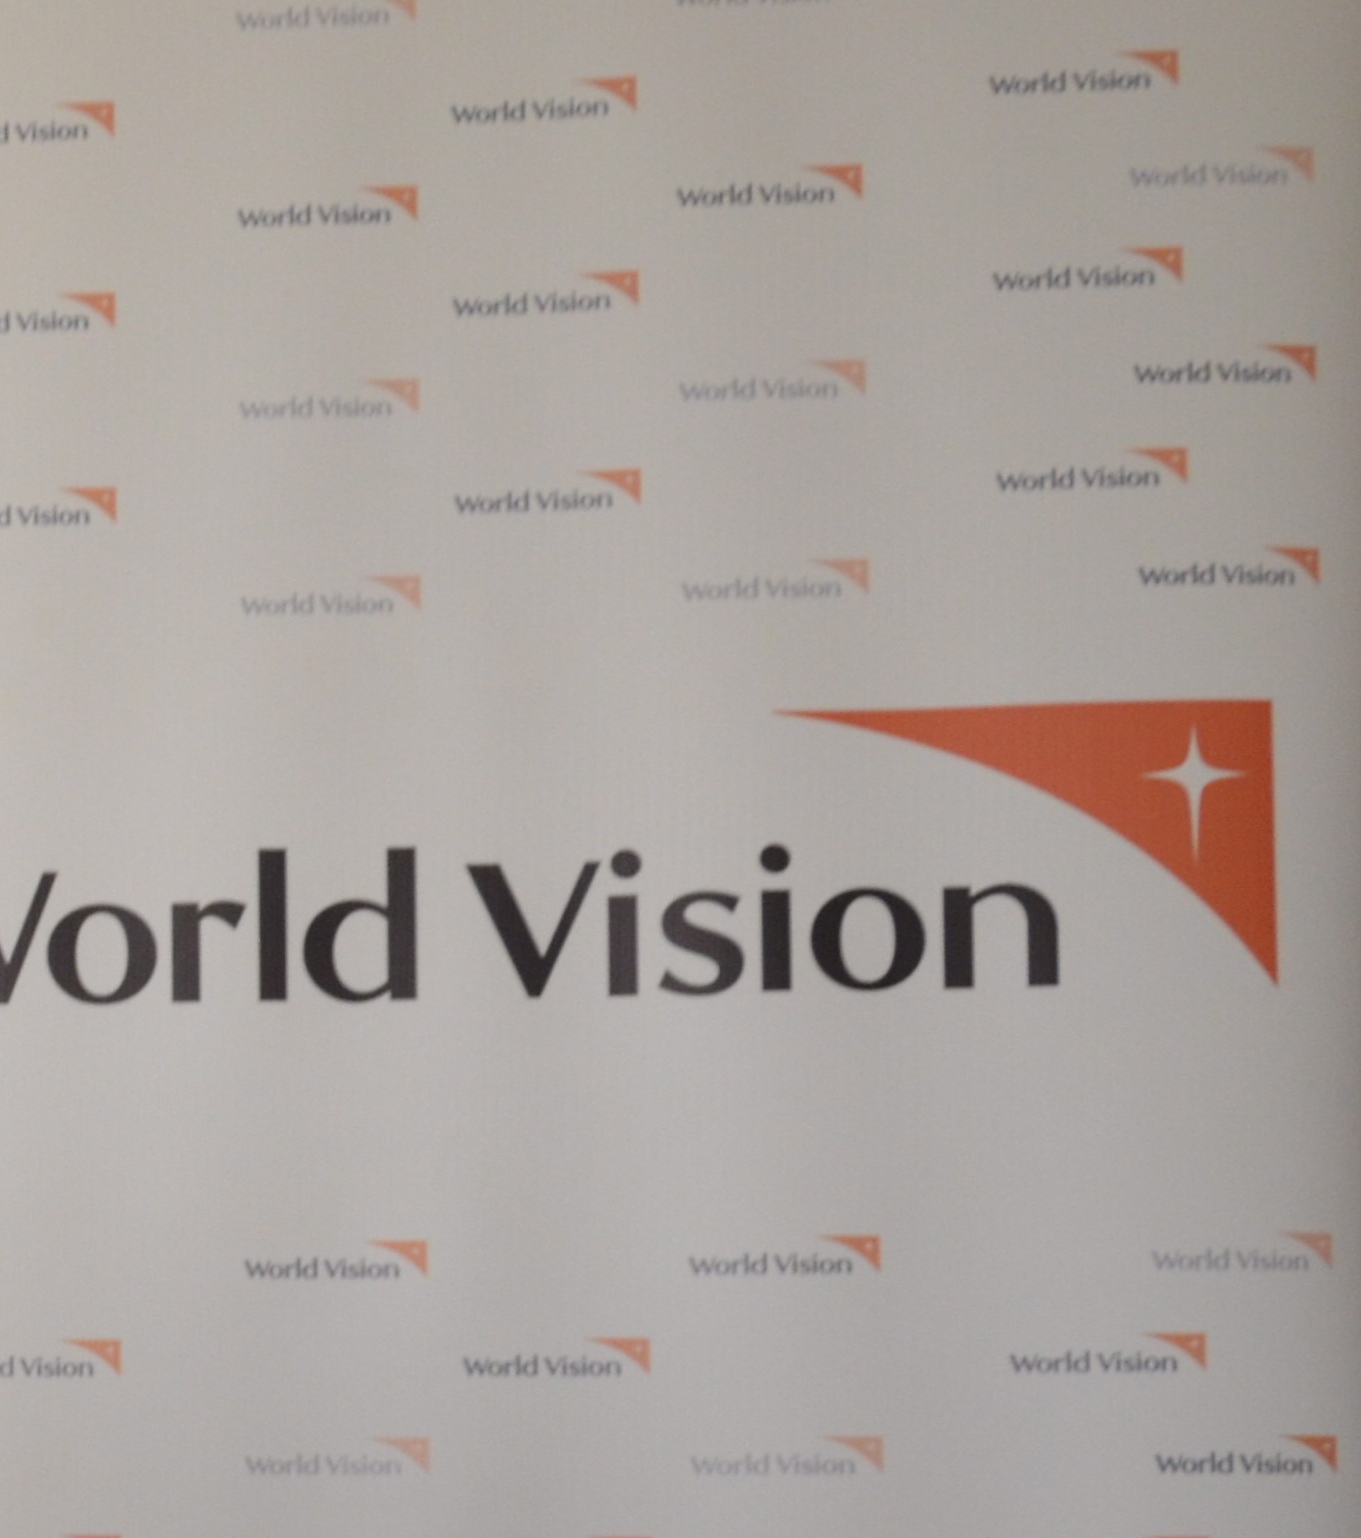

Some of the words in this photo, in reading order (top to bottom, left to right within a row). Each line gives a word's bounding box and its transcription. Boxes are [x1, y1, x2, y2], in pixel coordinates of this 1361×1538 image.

[988, 70, 1067, 95] World
[1072, 70, 1152, 92] Vision
[452, 292, 528, 318] World
[533, 290, 612, 313] Vision
[1137, 562, 1216, 587] World
[1220, 564, 1296, 586] Vision
[466, 844, 1059, 998] Vision
[244, 1256, 319, 1280] World
[323, 1259, 401, 1280] Vision
[688, 1252, 768, 1277] World
[773, 1253, 854, 1275] Vision
[1155, 1451, 1234, 1474] World
[1239, 1453, 1314, 1475] Vision
